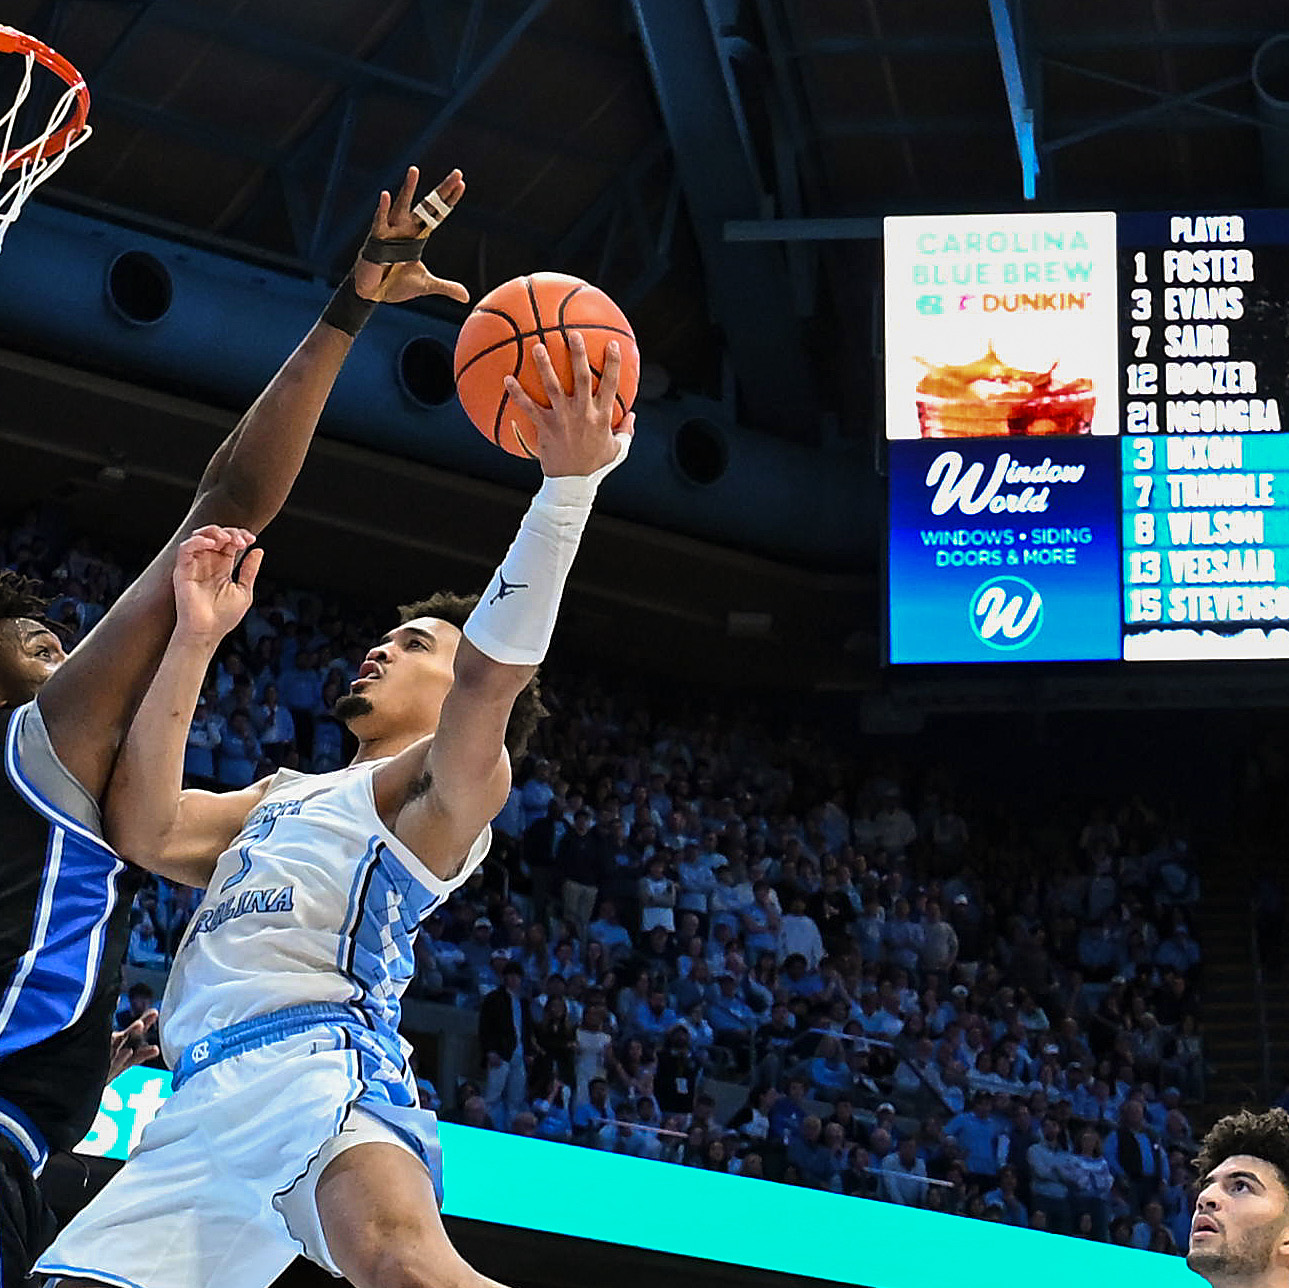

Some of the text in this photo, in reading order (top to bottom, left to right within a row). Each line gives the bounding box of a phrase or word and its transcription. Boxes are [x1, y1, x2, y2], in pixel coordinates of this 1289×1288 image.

[916, 231, 1089, 254] CAROLINA
[1171, 216, 1244, 243] PLAYER
[912, 261, 1093, 285] BLUE BREW
[1134, 252, 1148, 283] 1
[1164, 250, 1254, 283] FOSTER
[1131, 289, 1152, 320] 3
[1164, 287, 1244, 320] EVANS
[1132, 326, 1151, 357] 7
[1164, 324, 1229, 357] SARR
[1127, 363, 1158, 395] 12
[1166, 361, 1257, 395] BOOZER
[1127, 402, 1159, 433] 21
[1133, 438, 1154, 470] 3
[926, 451, 1085, 515] Window
[1133, 475, 1153, 507] 7
[920, 528, 1093, 546] WINDOWS SIDING
[1134, 513, 1155, 545] 8
[1167, 511, 1264, 545] WILSON
[935, 548, 1077, 567] DOORS & MORE
[1129, 551, 1161, 583] 13
[1168, 549, 1275, 583] VEESAAR
[1130, 589, 1162, 621] 15
[181, 886, 294, 952] ROLINA
